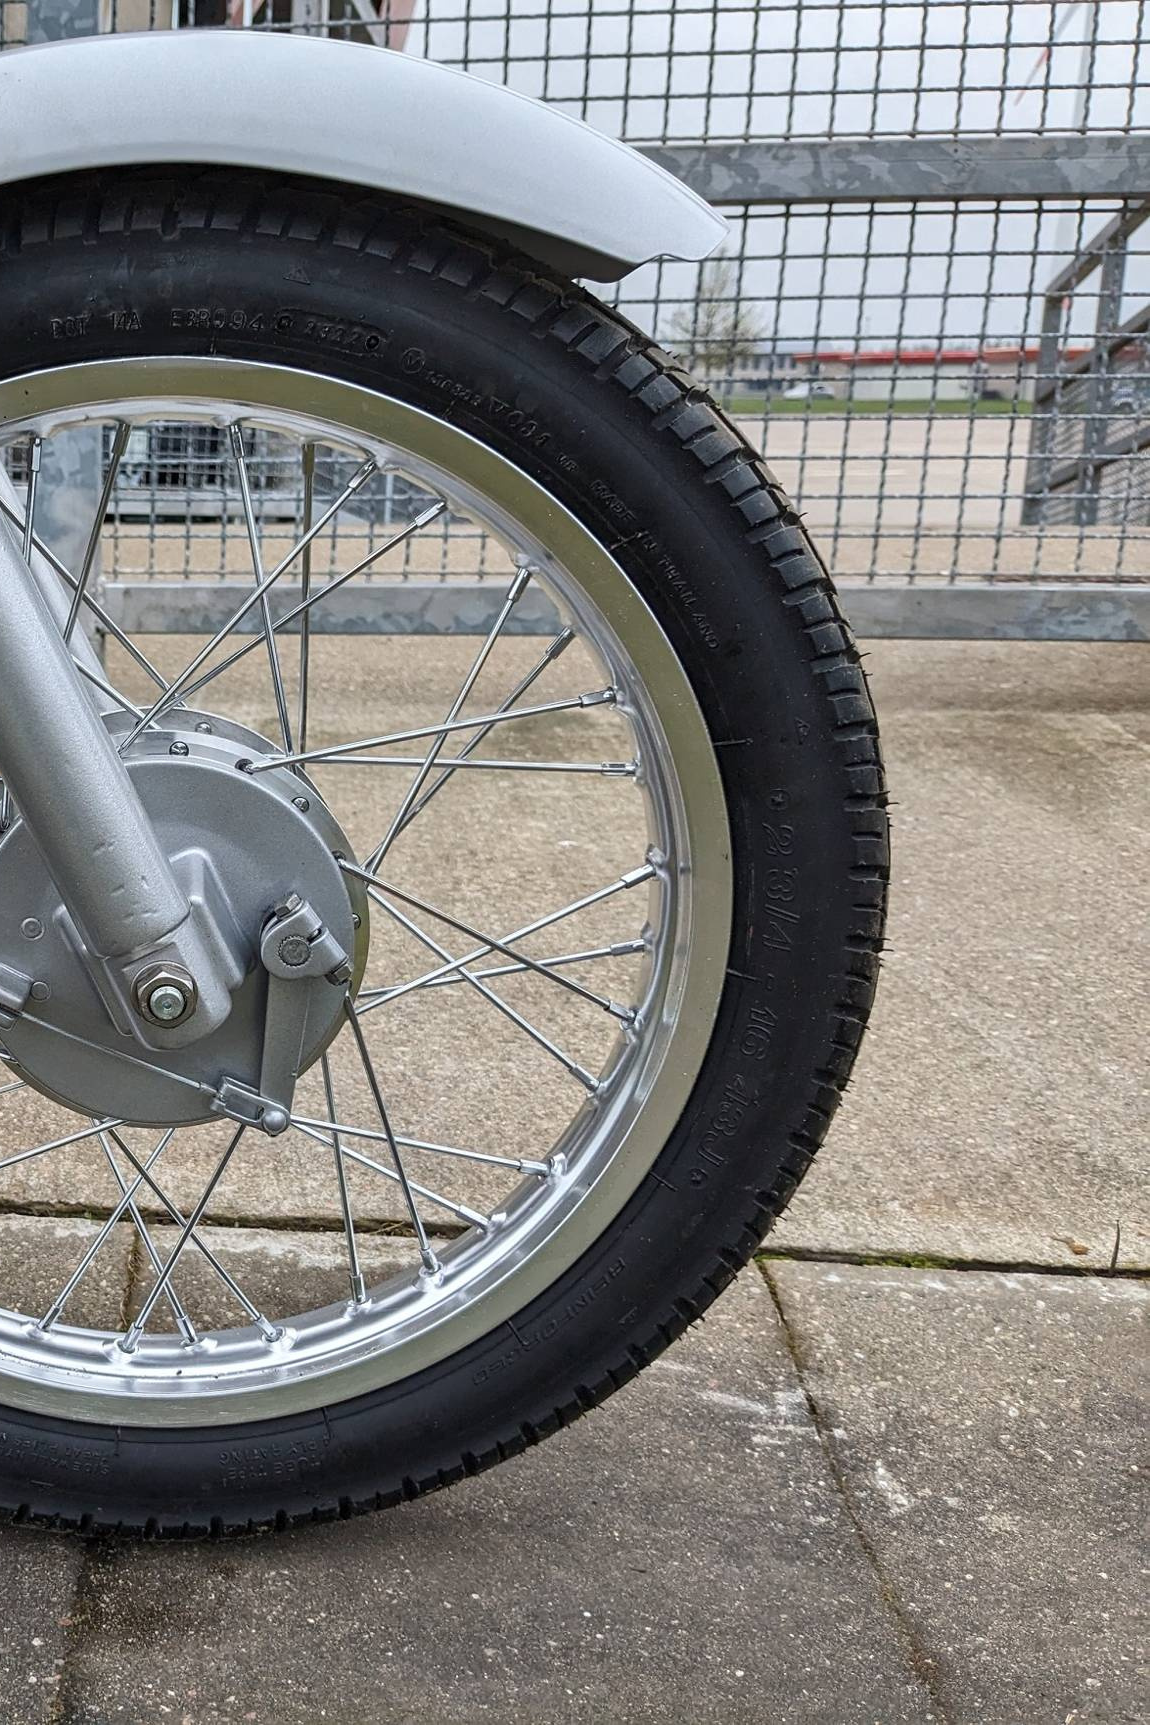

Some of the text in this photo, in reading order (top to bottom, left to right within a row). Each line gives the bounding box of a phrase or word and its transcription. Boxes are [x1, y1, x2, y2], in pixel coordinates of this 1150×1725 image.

[591, 479, 637, 522] MADE
[658, 556, 720, 650] THAILAND
[741, 1004, 778, 1061] 16
